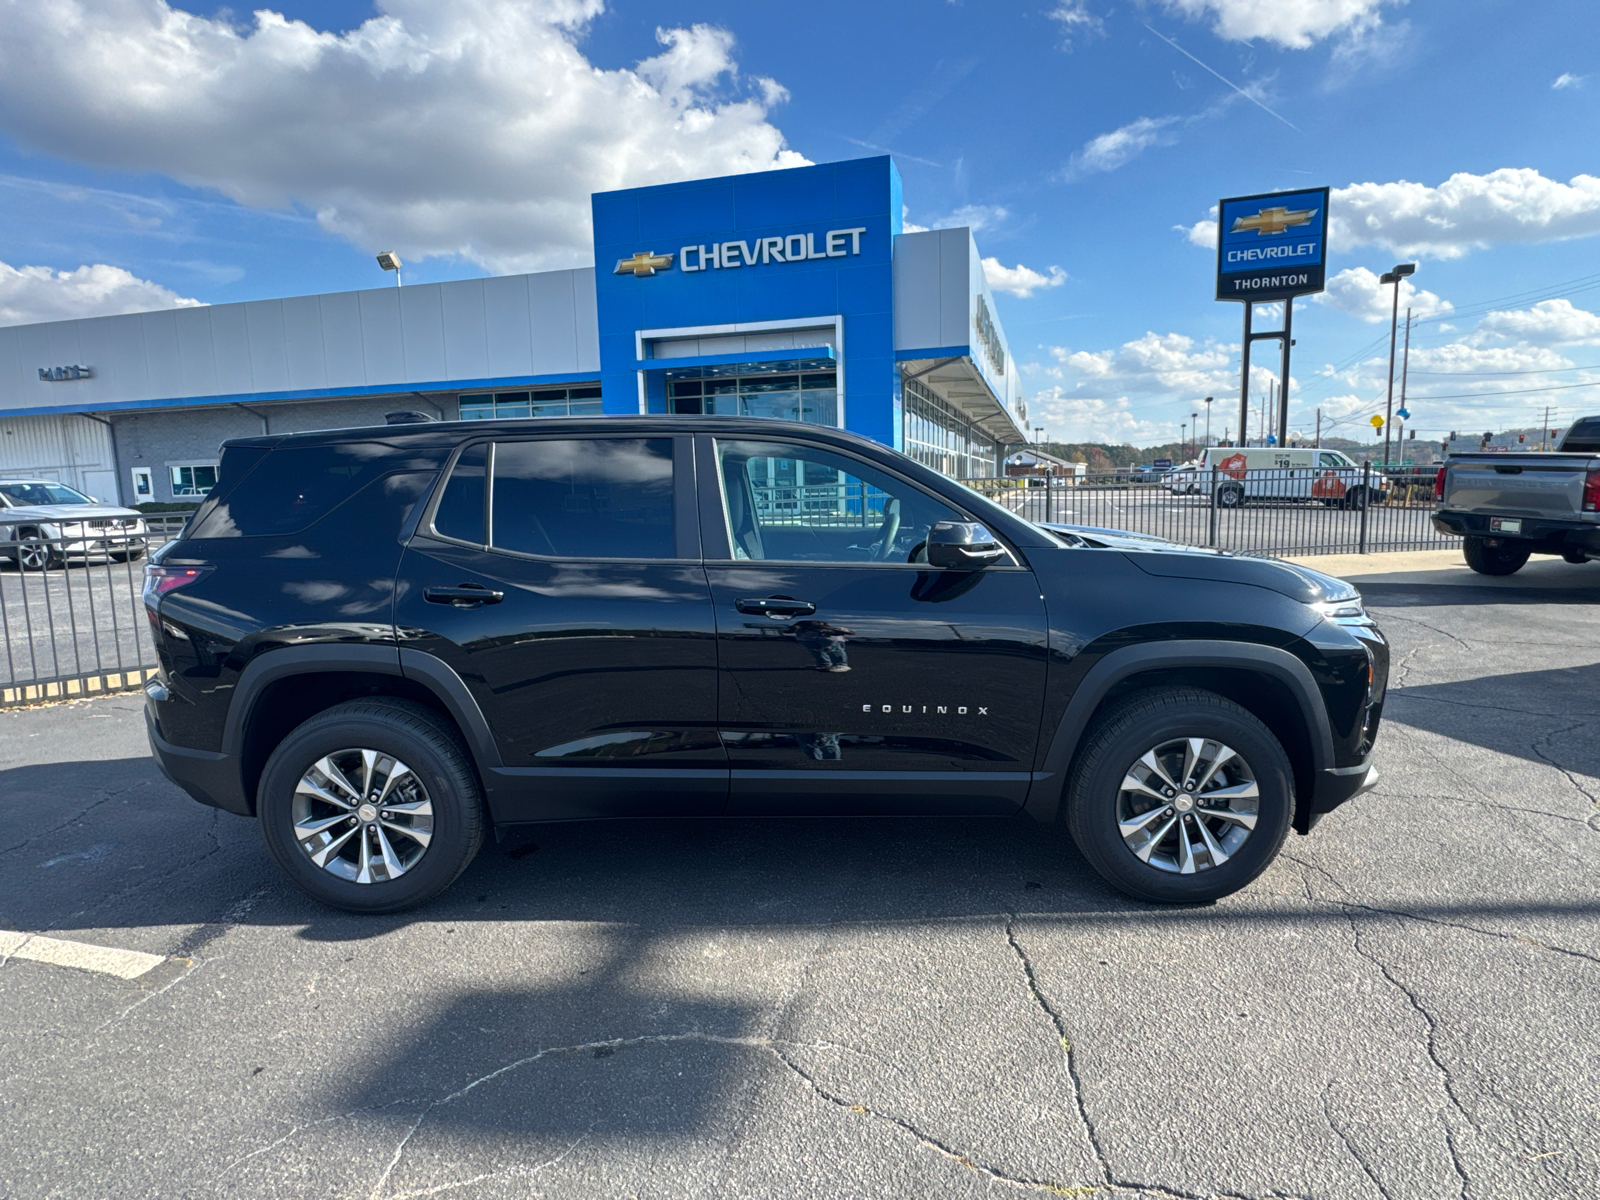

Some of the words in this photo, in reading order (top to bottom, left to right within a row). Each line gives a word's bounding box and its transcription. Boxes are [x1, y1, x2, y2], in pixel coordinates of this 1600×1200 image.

[680, 227, 866, 272] CHEVROLET
[1227, 242, 1316, 262] CHEVROLET
[1234, 274, 1308, 290] THORNTON
[38, 365, 84, 381] PARTS
[1274, 460, 1290, 468] $19
[861, 704, 988, 715] EQUINOX
